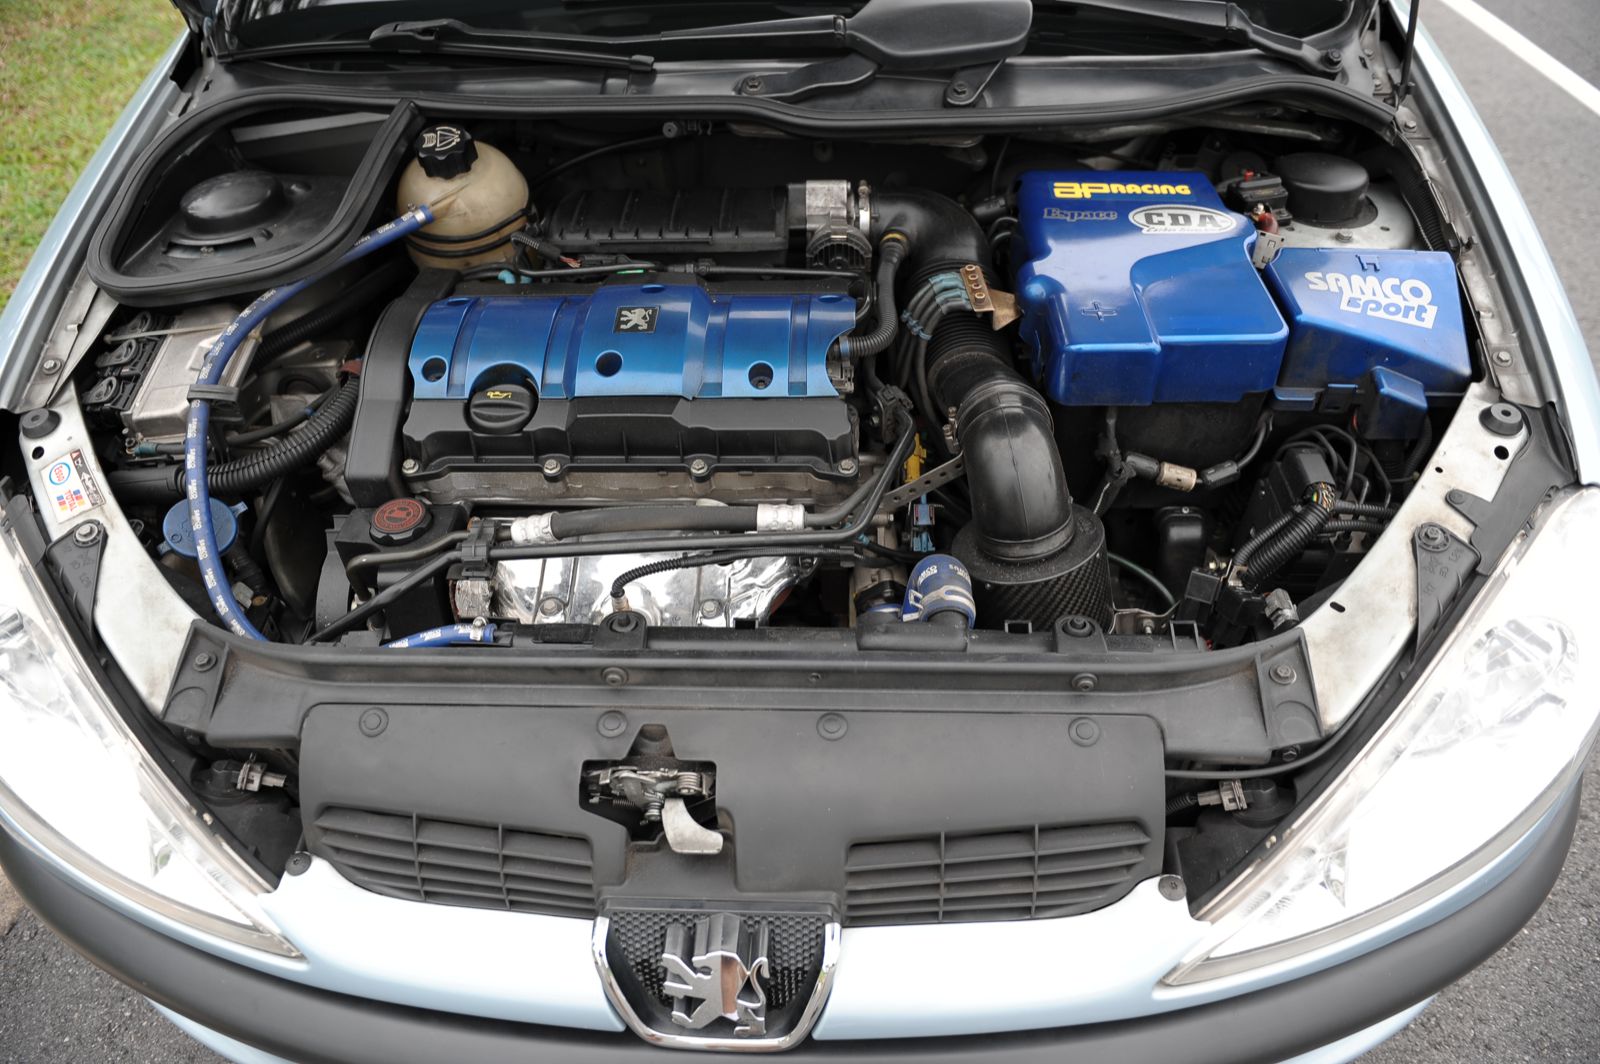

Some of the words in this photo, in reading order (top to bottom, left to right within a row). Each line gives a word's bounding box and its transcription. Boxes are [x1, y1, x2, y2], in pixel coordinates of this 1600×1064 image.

[1144, 212, 1223, 228] CDA
[1304, 271, 1433, 303] SAMCO
[64, 489, 78, 512] TOTAL
